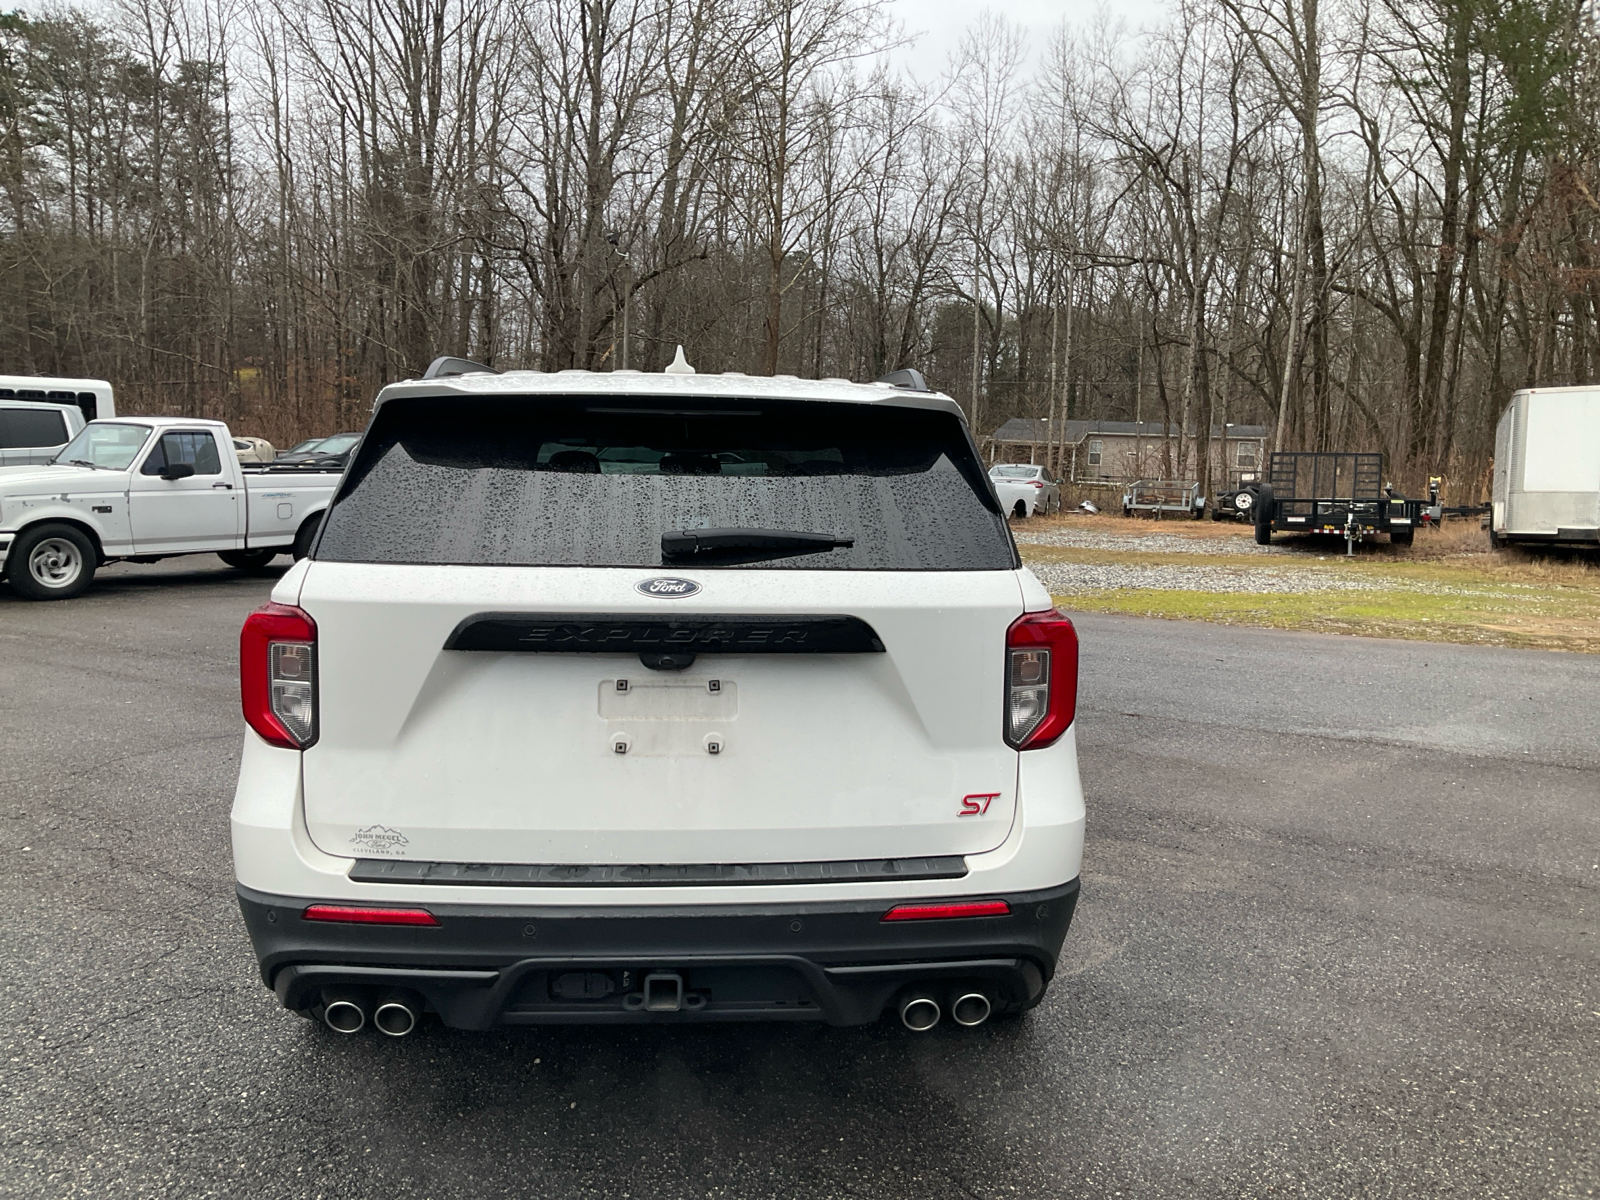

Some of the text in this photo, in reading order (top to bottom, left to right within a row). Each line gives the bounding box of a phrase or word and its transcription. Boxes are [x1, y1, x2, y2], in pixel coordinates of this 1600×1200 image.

[650, 580, 687, 592] Ford
[518, 627, 809, 643] EXPLORER
[957, 792, 1001, 817] ST
[355, 833, 401, 842] JOHN MEGEL
